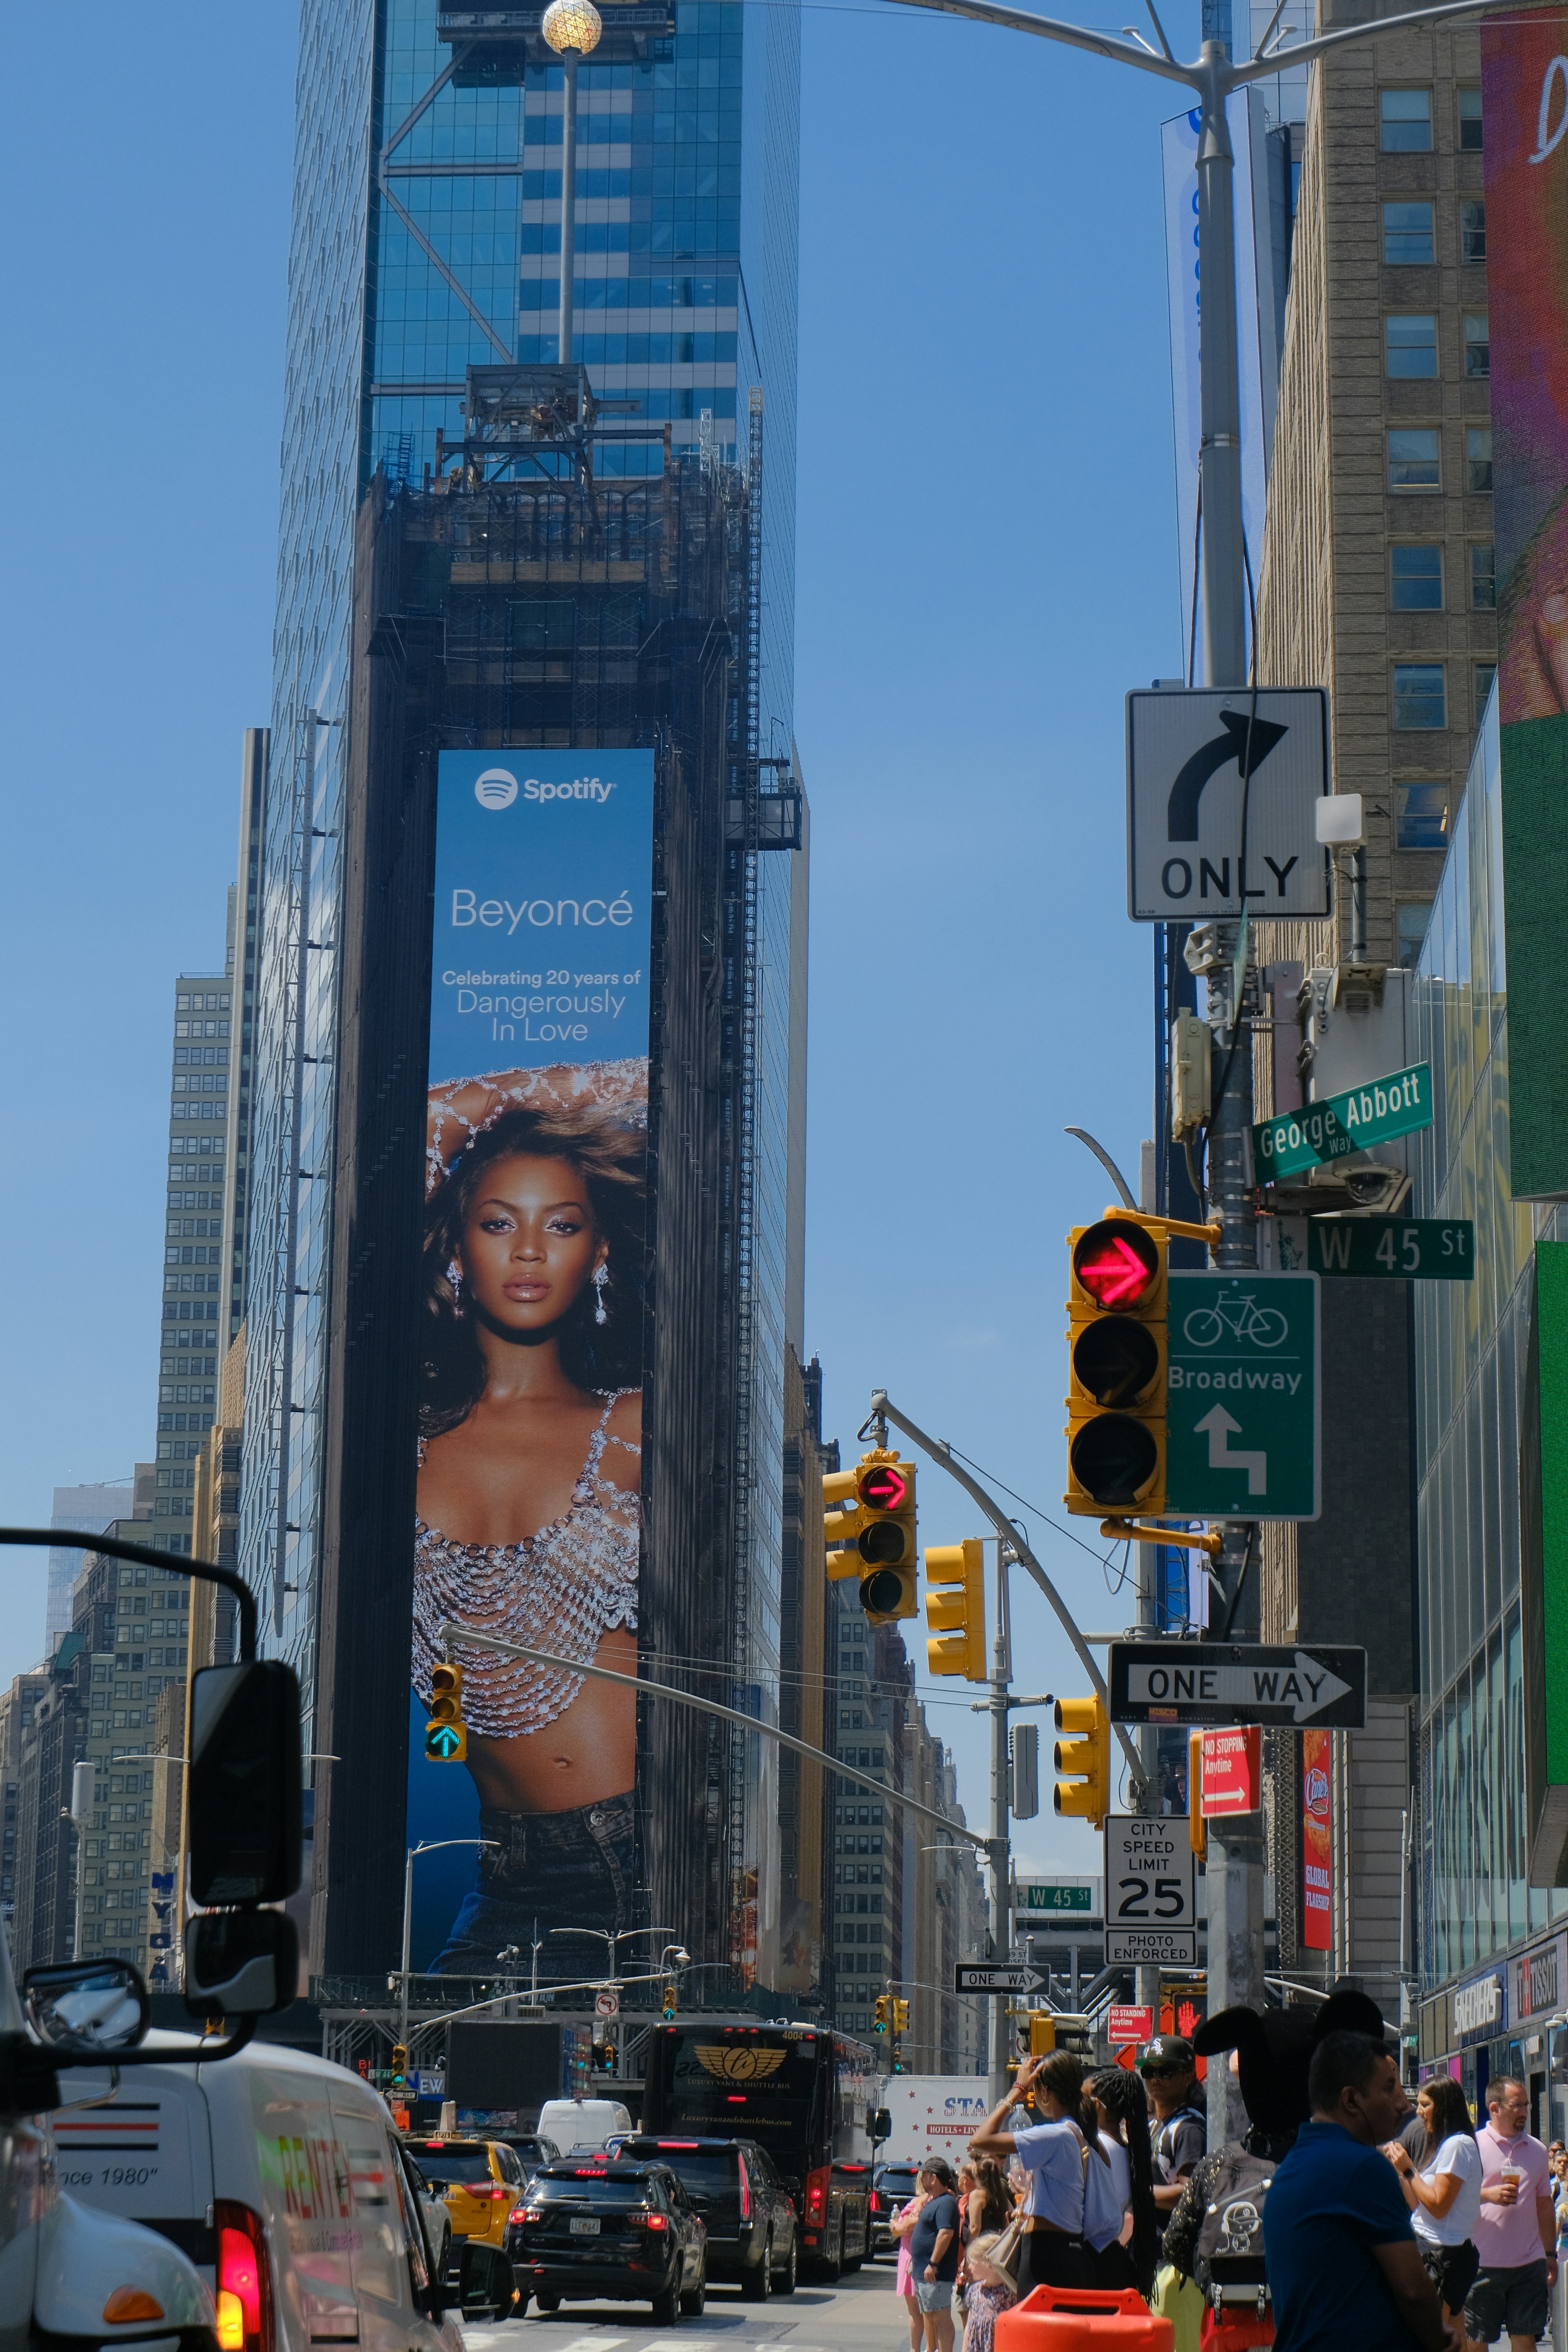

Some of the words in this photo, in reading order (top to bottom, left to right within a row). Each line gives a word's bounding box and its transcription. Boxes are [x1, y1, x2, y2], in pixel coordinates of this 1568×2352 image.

[1161, 856, 1299, 899] ONLY
[453, 889, 633, 935] Beyoncé
[442, 970, 542, 988] Celebrating
[547, 970, 570, 984] 20
[574, 973, 619, 988] years
[623, 970, 641, 984] of
[458, 989, 626, 1018] Dangerously
[493, 1018, 514, 1041] In
[525, 1018, 588, 1041] Love
[1261, 1108, 1336, 1158] George
[1347, 1073, 1420, 1128] Abbott
[1330, 1136, 1351, 1155] Way
[1319, 1226, 1352, 1268] W
[1376, 1228, 1420, 1270] 45
[1441, 1229, 1465, 1256] St
[1168, 1367, 1302, 1395] Broadway
[1148, 1669, 1217, 1699] ONE
[1254, 1672, 1326, 1702] WAY
[1206, 1740, 1214, 1755] NO
[1217, 1736, 1247, 1754] STOPPING
[1205, 1758, 1232, 1777] Anytime
[1131, 1824, 1166, 1836] CITY
[1123, 1841, 1174, 1853] SPEED
[1129, 1858, 1169, 1870] LIMIT
[1306, 1865, 1329, 1888] GLOBAL
[1032, 1888, 1045, 1906] W
[1054, 1890, 1071, 1906] 45
[1079, 1890, 1088, 1901] St
[1118, 1877, 1184, 1917] 25
[1306, 1891, 1329, 1911] FLAGSHIP
[1129, 1936, 1173, 1946] PHOTO
[1115, 1948, 1187, 1959] ENFORCED
[969, 1973, 995, 1985] ONE
[1008, 1974, 1035, 1986] WAY
[1530, 1953, 1557, 2007] TISSOT
[1454, 1973, 1502, 2035] SKECHERS
[1111, 2018, 1133, 2026] Anytime
[782, 2031, 803, 2040] 4004
[944, 2097, 988, 2116] STA
[681, 2113, 792, 2125] Luxuryvanandshuttlebus.com
[60, 2169, 93, 2184] nce
